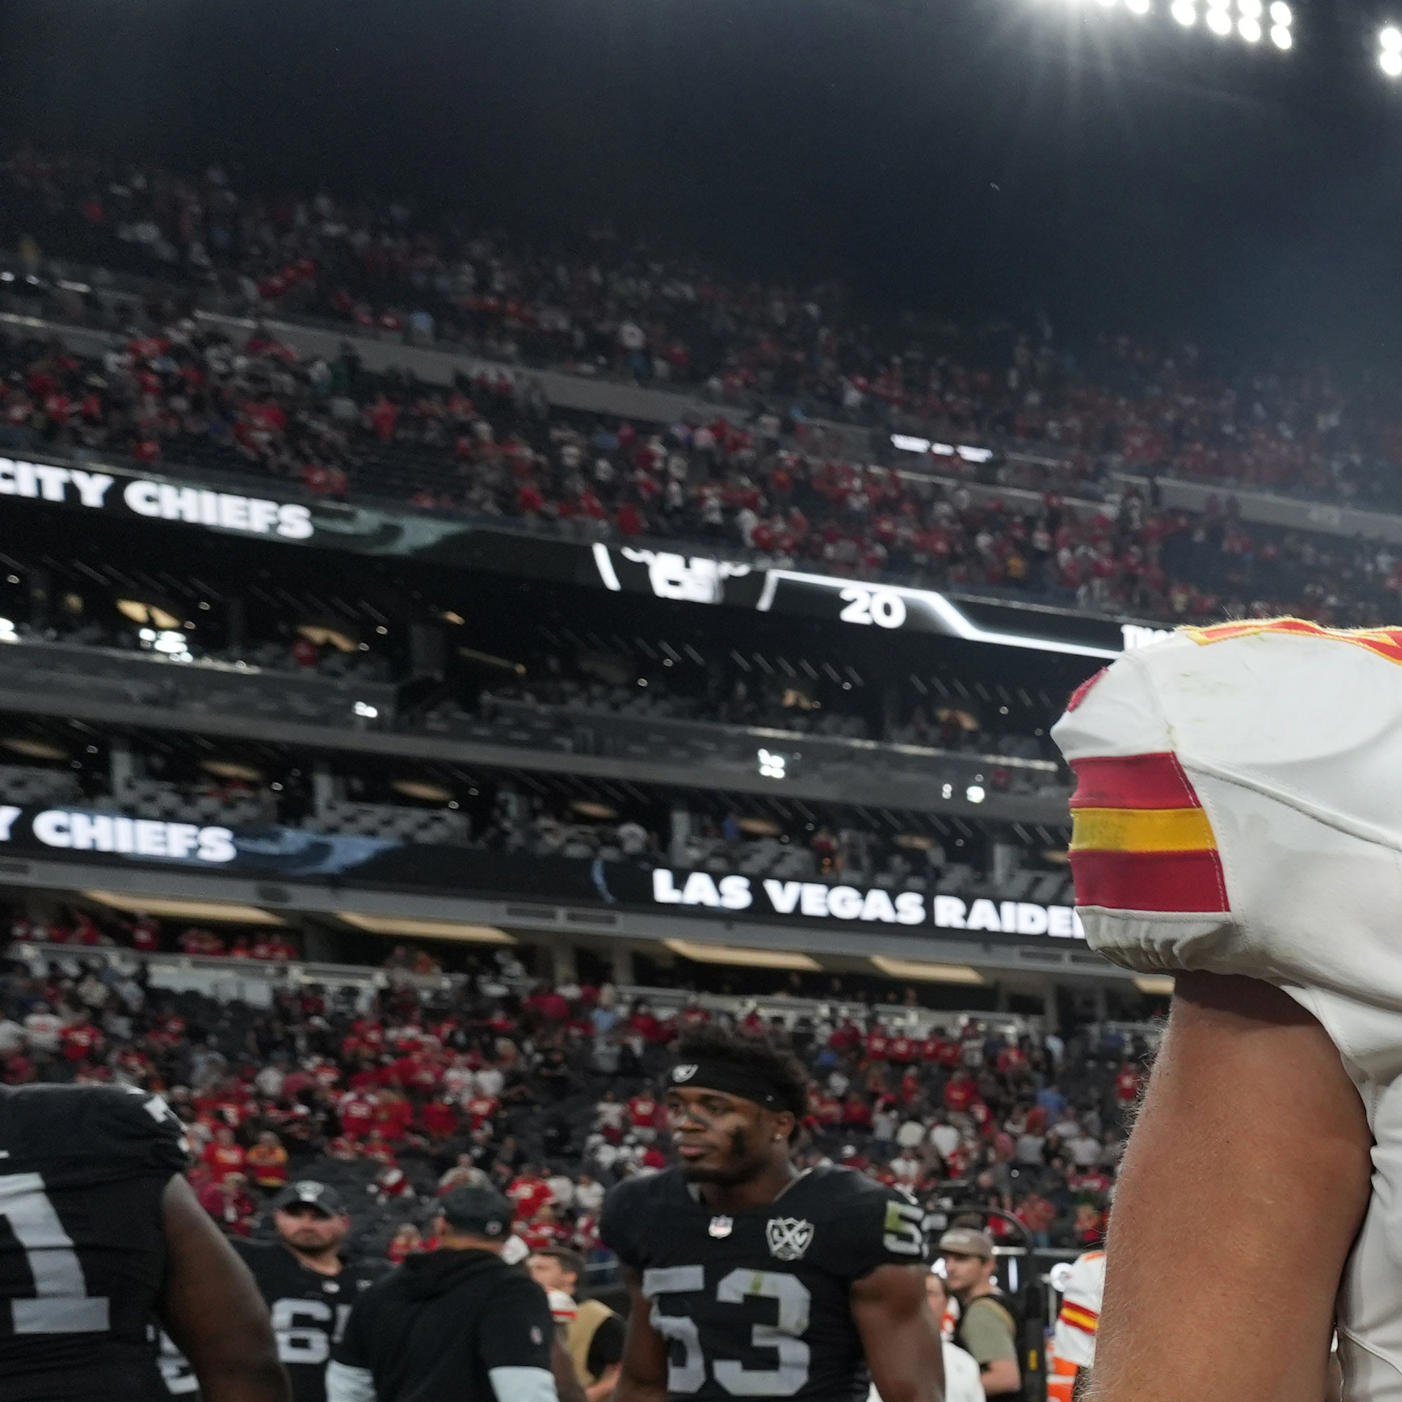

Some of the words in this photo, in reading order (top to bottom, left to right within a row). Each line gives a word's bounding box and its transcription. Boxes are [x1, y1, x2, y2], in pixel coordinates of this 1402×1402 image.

[123, 480, 314, 539] CHIEFS
[839, 587, 906, 629] 20
[32, 809, 237, 863] CHIEFS
[652, 868, 753, 910] LAS
[763, 879, 926, 925] VEGAS
[933, 895, 1084, 939] RAIDE
[271, 1297, 353, 1365] 6
[641, 1264, 811, 1397] 53
